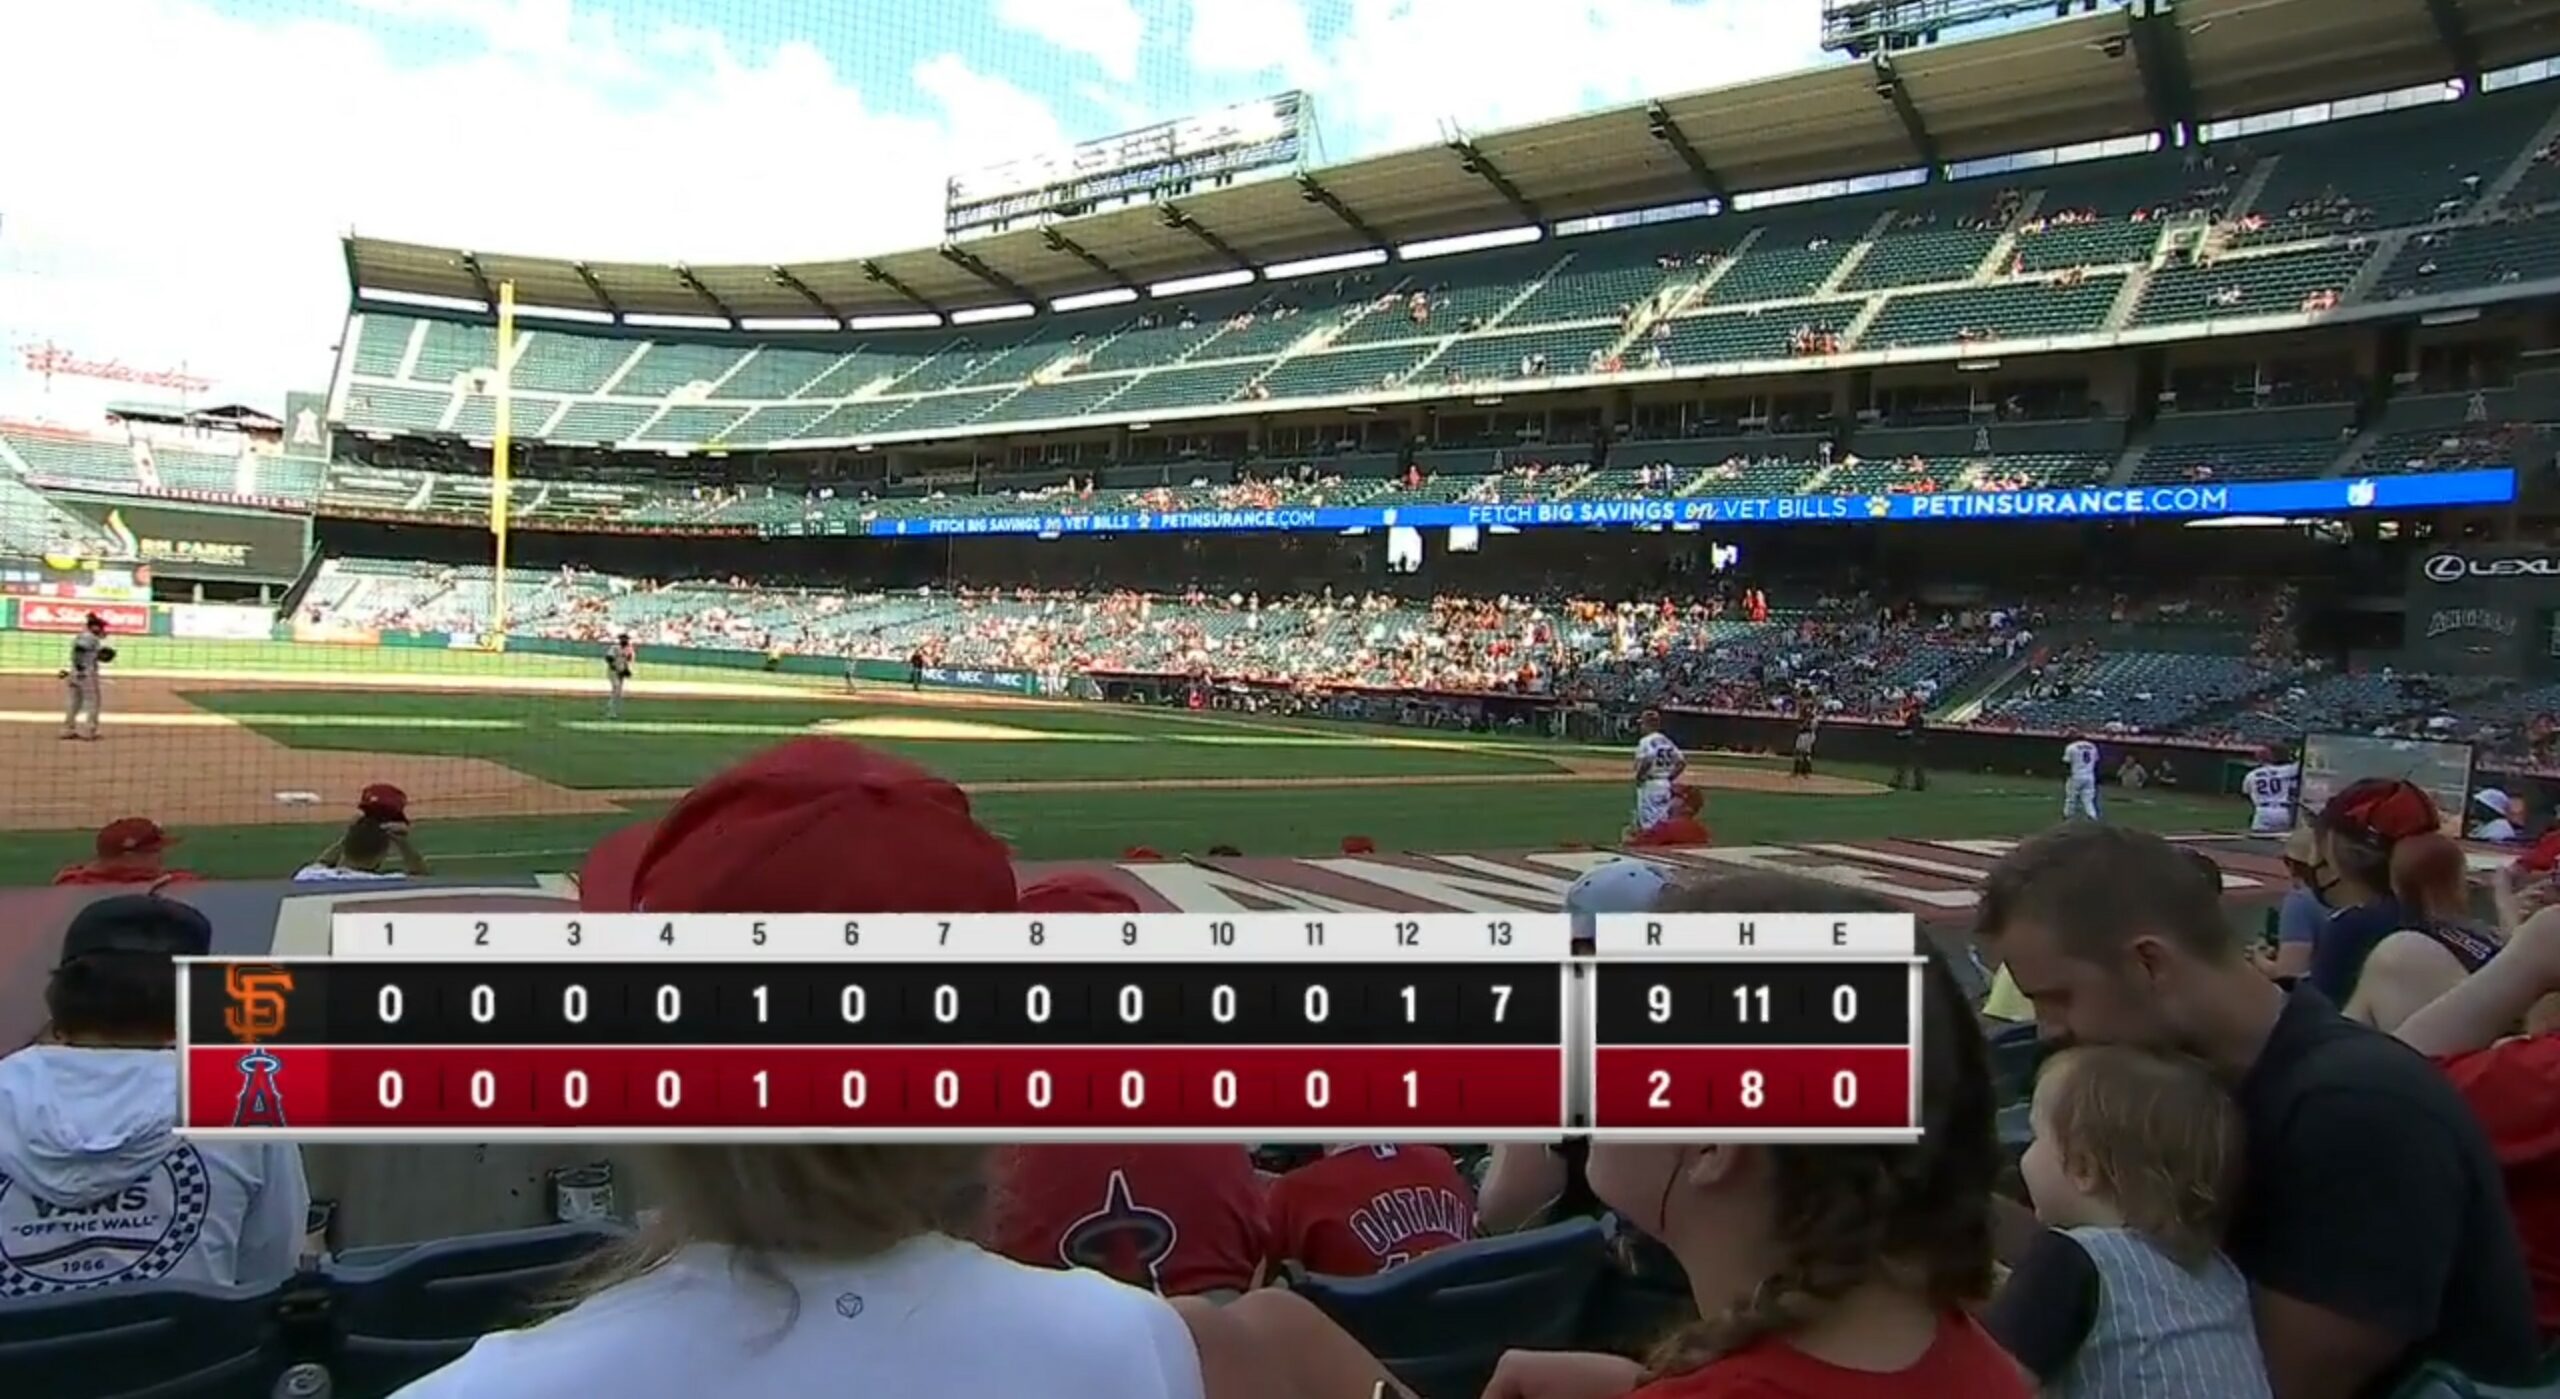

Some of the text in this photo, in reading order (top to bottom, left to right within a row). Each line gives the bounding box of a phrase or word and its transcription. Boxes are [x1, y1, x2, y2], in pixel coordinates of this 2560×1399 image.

[1912, 487, 2227, 515] PETINSURANCE.COM
[1160, 510, 1316, 528] PETINSURANCE.COM
[1468, 498, 1847, 523] FETCH BIG SAVINGS on VET BILLS
[929, 516, 965, 532] FETCH
[966, 516, 988, 532] BIG
[989, 515, 1041, 532] SAVINGS
[1065, 514, 1090, 530] VET
[1093, 513, 1130, 529] BILLS
[921, 668, 1022, 687] NEC NEC NEC
[2255, 778, 2282, 796] 20
[61, 1219, 98, 1233] THE
[62, 1260, 105, 1273] 1966
